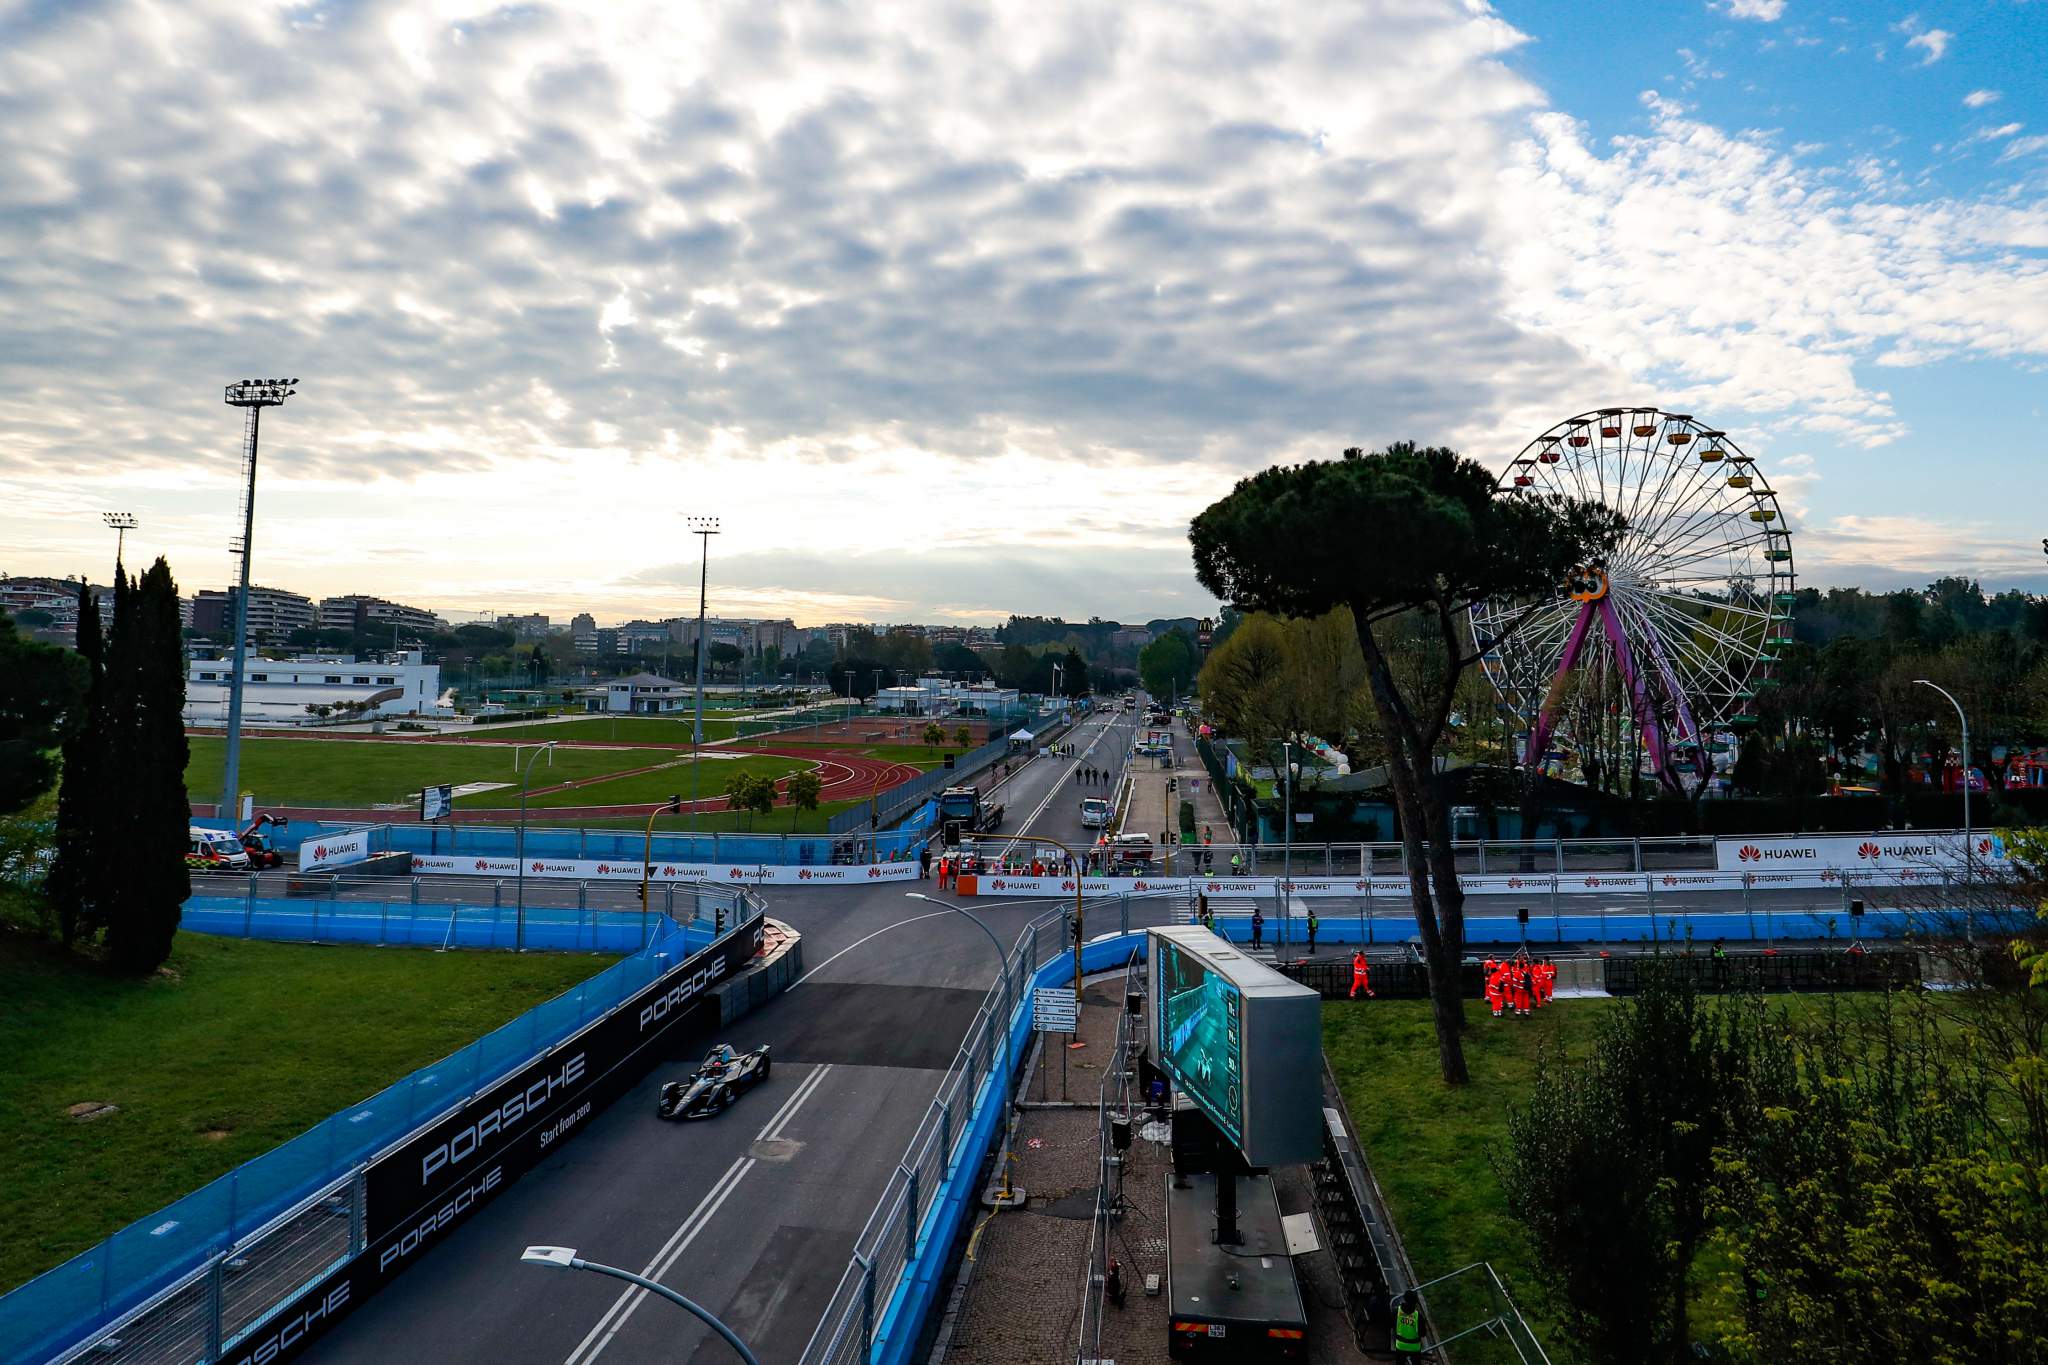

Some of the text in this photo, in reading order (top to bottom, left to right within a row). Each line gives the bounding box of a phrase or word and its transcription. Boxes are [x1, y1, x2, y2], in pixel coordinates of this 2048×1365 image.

[328, 842, 358, 856] HUAWEI
[1765, 848, 1816, 859] HUAWEI
[1884, 846, 1937, 857] HUAWEI
[425, 860, 454, 869] HUAWEI
[489, 863, 518, 871] HUAWEI
[545, 865, 575, 873] HUAWEI
[611, 867, 641, 875] HUAWEI
[677, 868, 708, 877] HUAWEI
[744, 870, 775, 879] HUAWEI
[813, 870, 845, 879] HUAWEI
[882, 867, 912, 876] HUAWEI
[1007, 882, 1040, 890] HUAWEI
[1372, 882, 1406, 890] HUAWEI
[1602, 878, 1636, 886] HUAWEI
[1149, 883, 1182, 891] HUAWEI
[640, 954, 726, 1032] PORSCHE
[422, 1052, 585, 1186] PORSCHE
[540, 1102, 590, 1148] Start from zero
[380, 1165, 502, 1273] PORSCHE
[238, 1280, 350, 1365] SCHE
